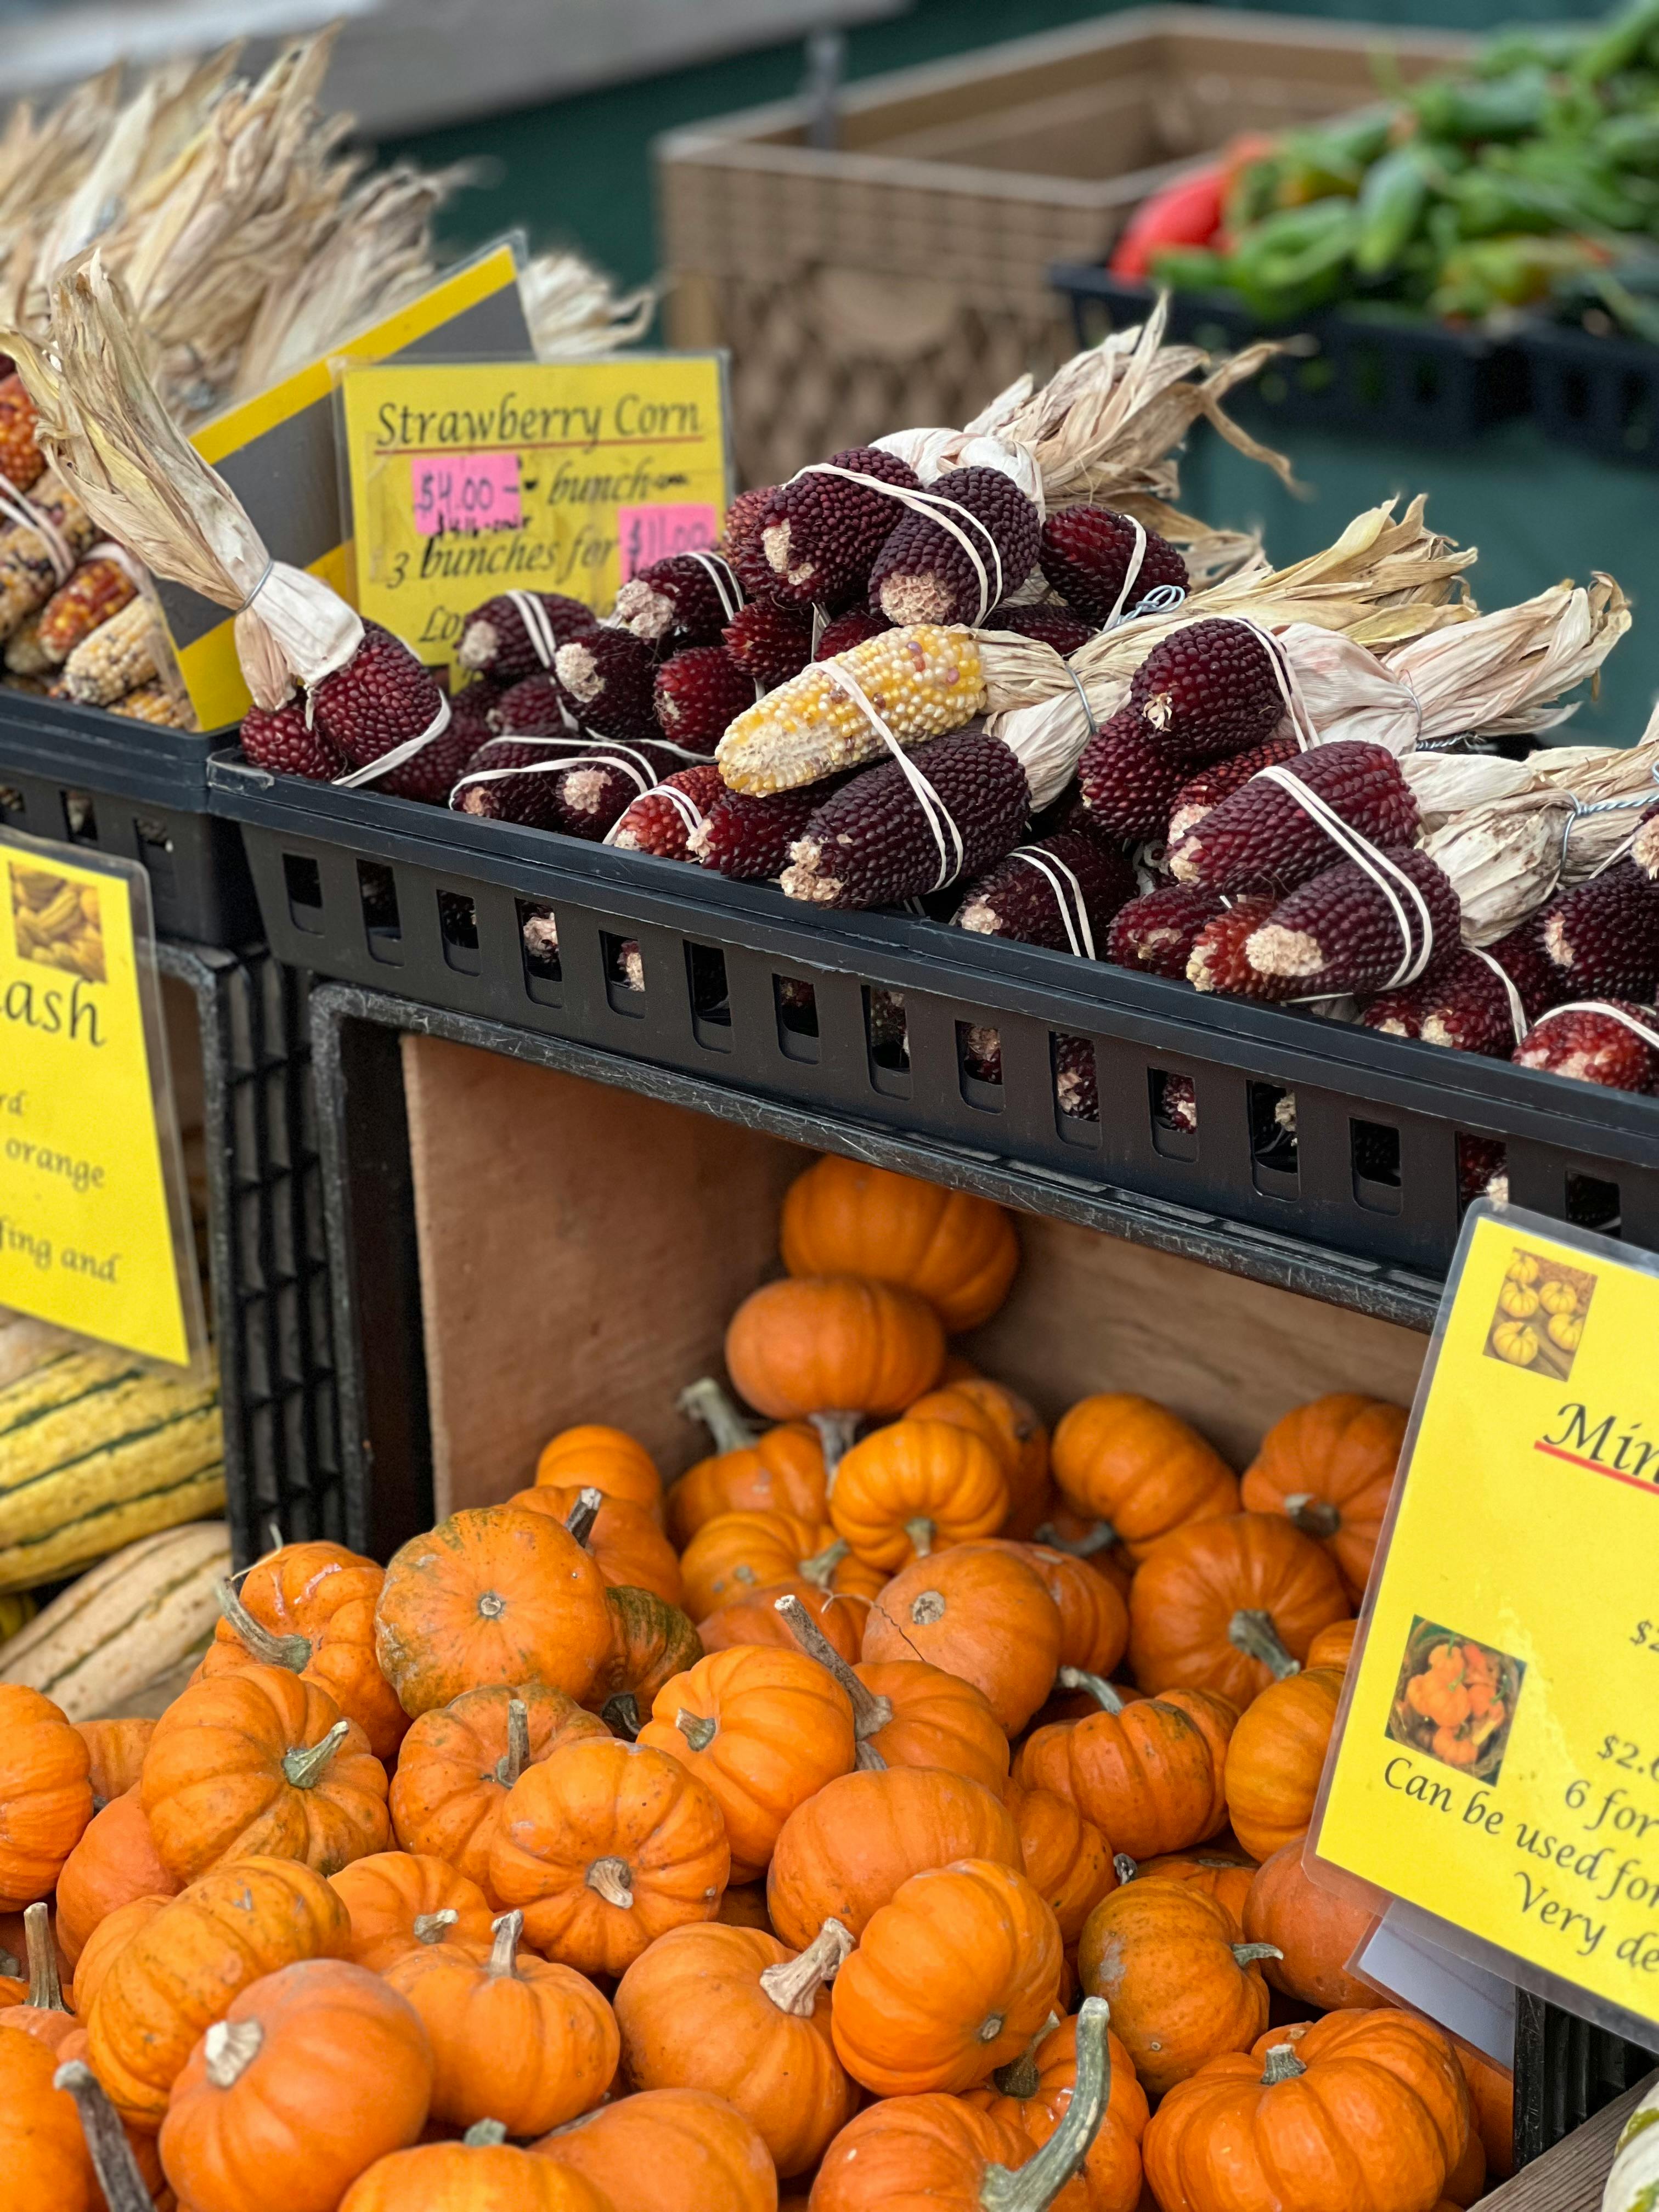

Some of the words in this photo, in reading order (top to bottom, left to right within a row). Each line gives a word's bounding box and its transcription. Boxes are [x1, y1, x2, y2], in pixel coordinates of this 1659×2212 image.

[376, 392, 602, 454] Strawberry
[616, 393, 701, 436] Corn
[548, 457, 653, 505] bunch
[386, 551, 410, 589] 3
[420, 532, 557, 579] bunches
[554, 523, 618, 585] for
[0, 976, 106, 1047] ash
[5, 1137, 106, 1193] orange
[60, 1247, 122, 1284] and
[1384, 1757, 1452, 1813] Can
[1462, 1790, 1504, 1835] be
[1516, 1823, 1616, 1880] used
[1565, 1780, 1591, 1809] 6
[1583, 1788, 1659, 1838] for
[1514, 1871, 1607, 1956] Very
